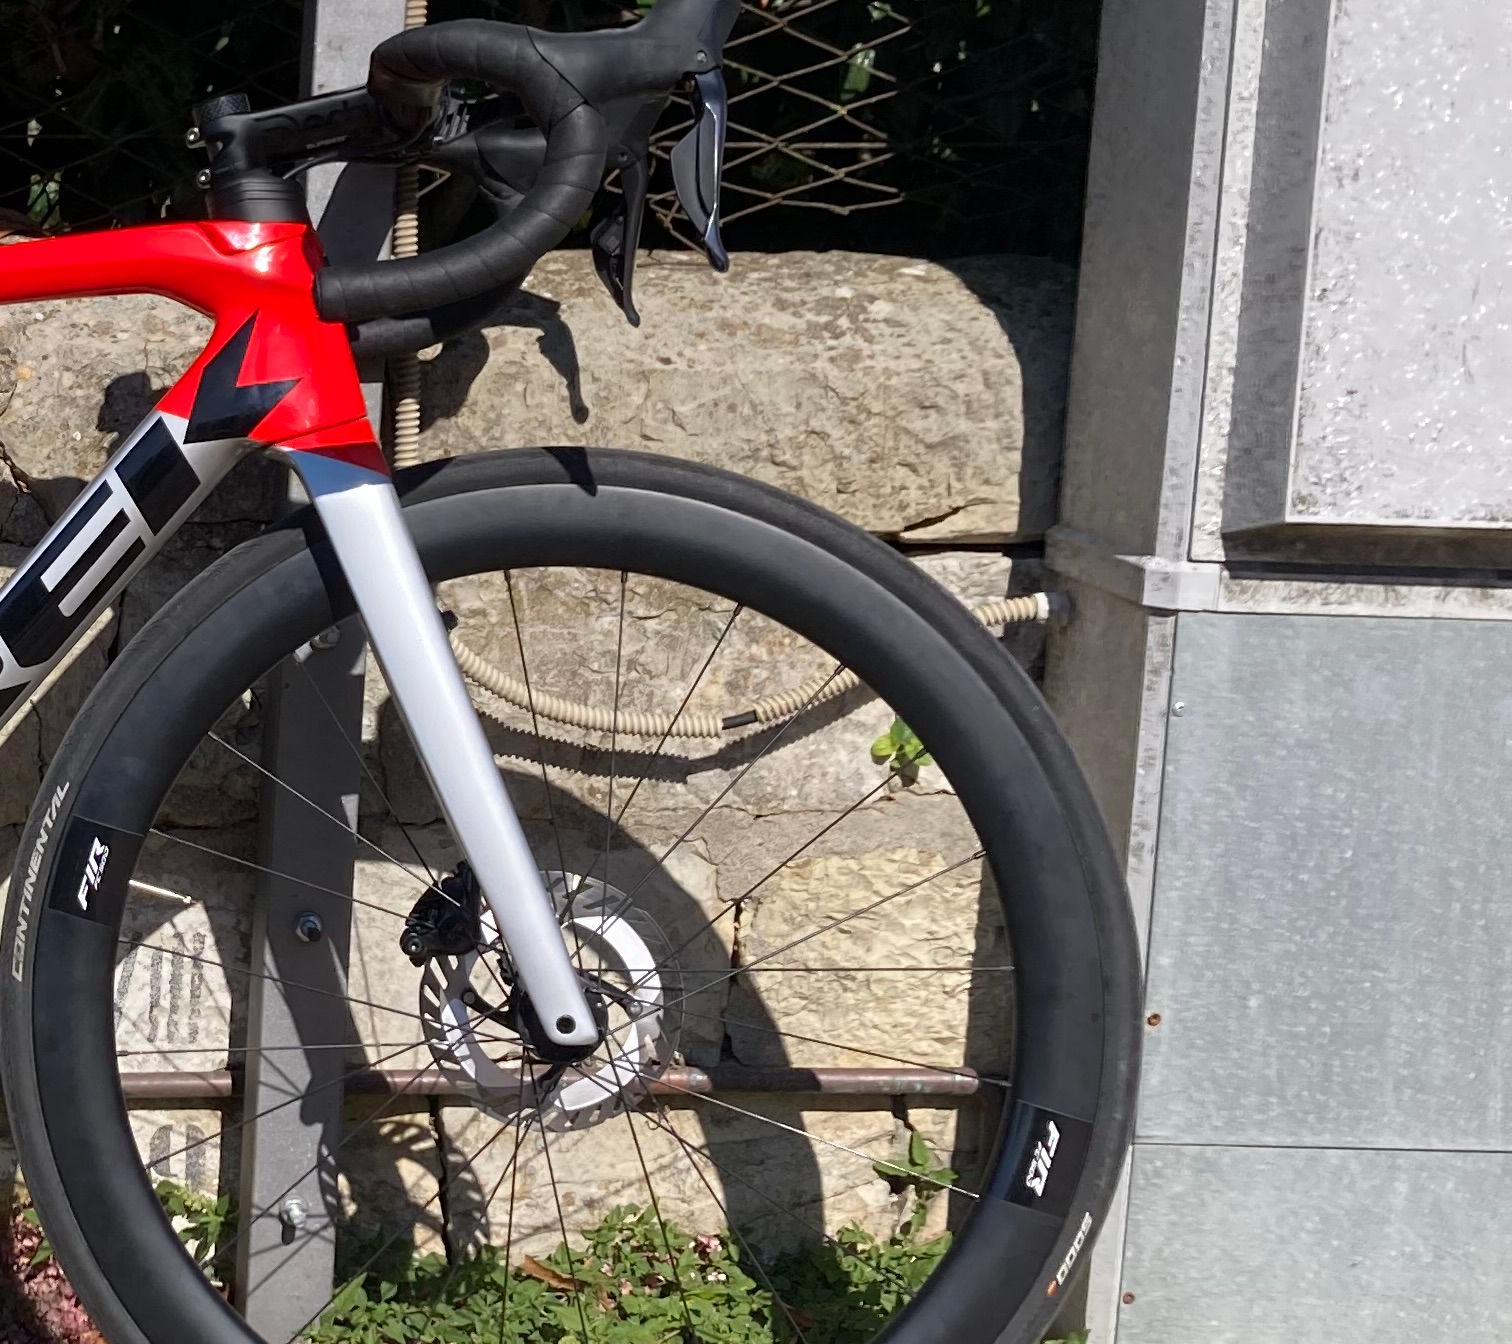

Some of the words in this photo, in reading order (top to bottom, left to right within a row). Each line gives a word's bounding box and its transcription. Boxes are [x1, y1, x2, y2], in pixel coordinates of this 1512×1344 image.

[12, 781, 70, 983] CONTINENTAL
[77, 836, 107, 911] FIR
[1029, 1120, 1060, 1197] FIR
